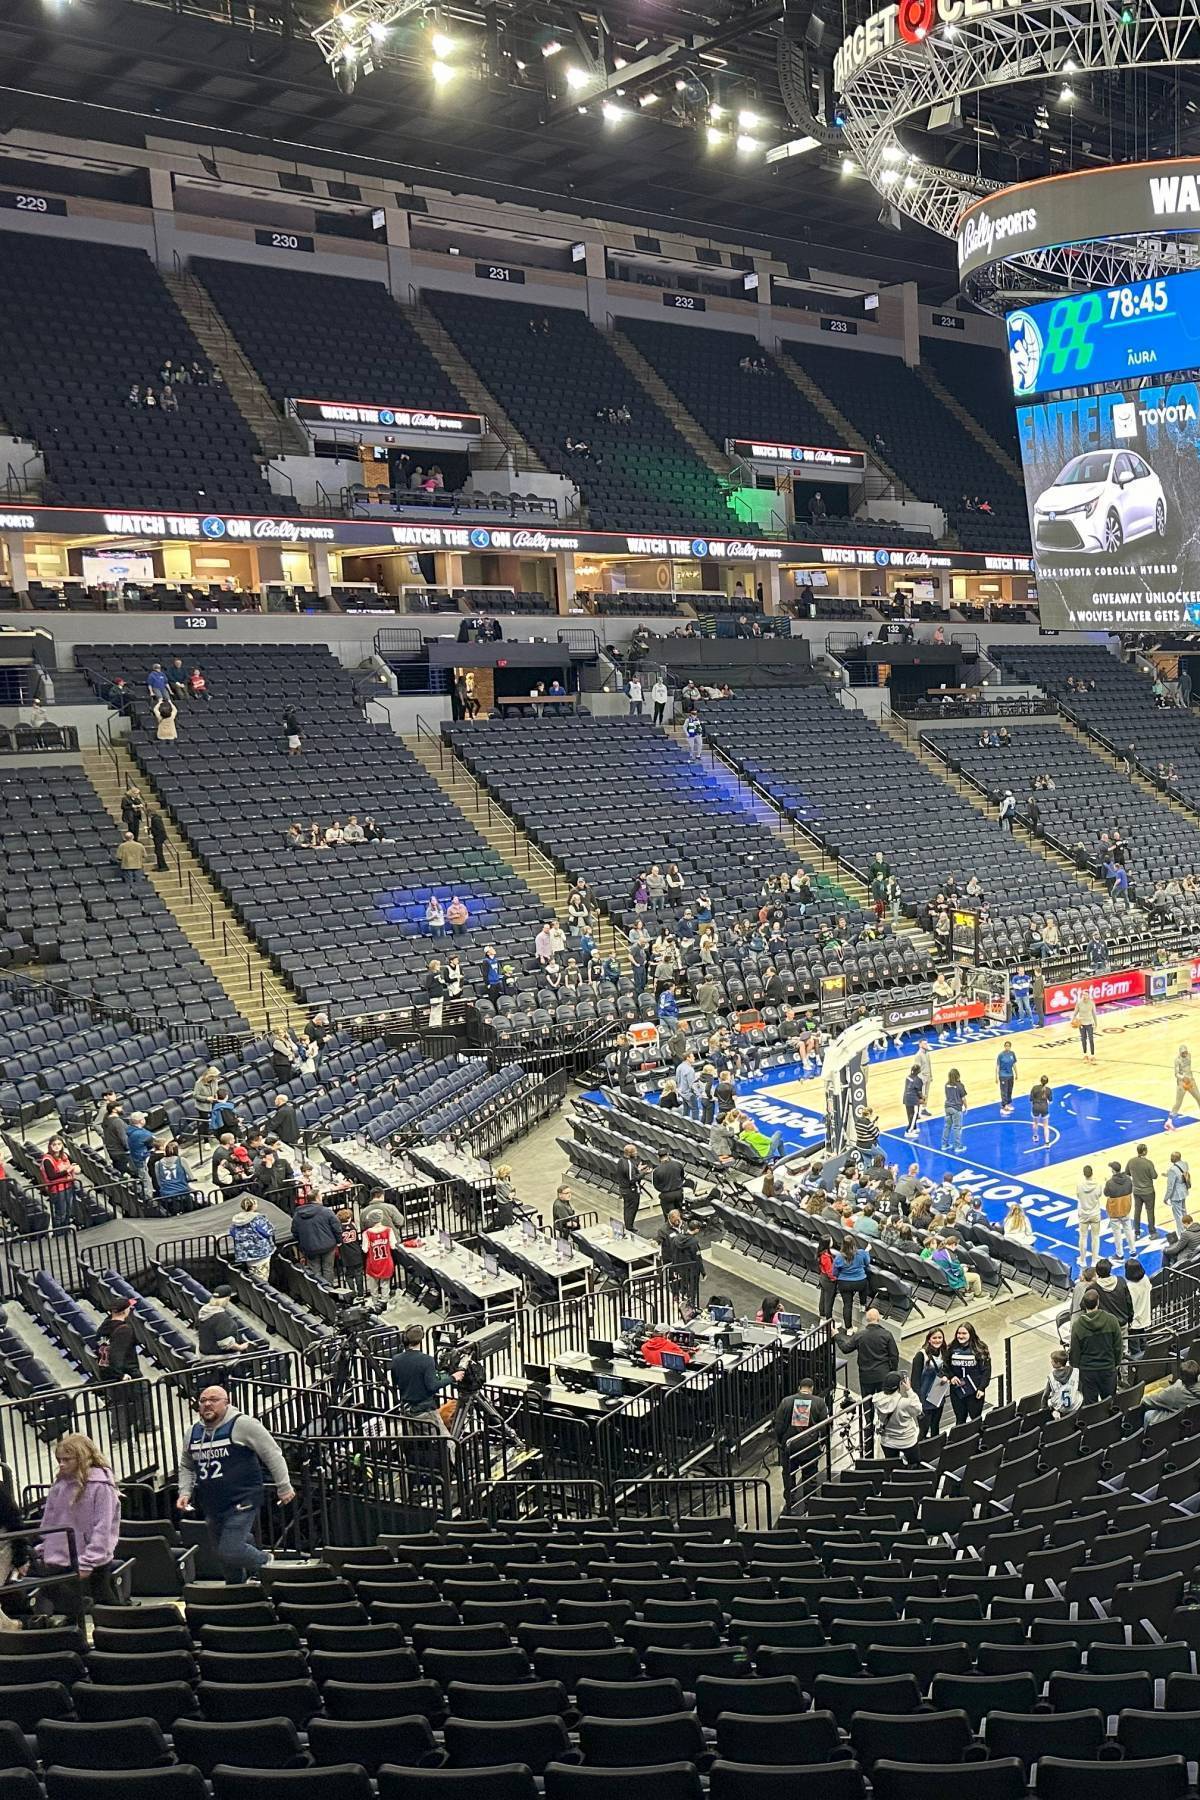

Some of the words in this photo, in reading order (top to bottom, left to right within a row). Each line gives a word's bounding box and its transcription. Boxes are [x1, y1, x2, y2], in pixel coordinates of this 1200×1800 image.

[833, 4, 899, 92] TARGET
[16, 196, 48, 212] 229
[964, 211, 995, 254] Bally
[994, 208, 1037, 240] SPORTS
[271, 233, 298, 249] 230
[489, 267, 510, 281] 231
[674, 296, 695, 309] 232
[1107, 281, 1168, 320] 78:45
[830, 320, 848, 332] 233
[941, 316, 956, 327] 234
[320, 405, 358, 422] WATCH
[411, 413, 441, 430] Bally
[1138, 402, 1197, 427] TOYOTA
[104, 514, 166, 534] WATCH
[167, 516, 199, 536] THE
[227, 518, 251, 537] ON
[253, 519, 302, 541] Bally
[300, 527, 334, 539] SPORTS
[392, 527, 443, 545] WATCH
[443, 529, 469, 546] THE
[491, 530, 511, 547] ON
[513, 531, 551, 551] Bally
[551, 538, 578, 549] SPORTS
[627, 537, 668, 554] WATCH
[669, 540, 691, 556] THE
[709, 541, 725, 556] ON
[727, 542, 759, 560] Bally
[821, 548, 855, 563] WATCH
[857, 550, 875, 564] THE
[890, 551, 904, 565] ON
[905, 552, 932, 568] Bally
[985, 557, 1013, 570] WATCH
[1013, 558, 1029, 571] THE
[1059, 566, 1091, 577] TOYOTA
[1095, 566, 1136, 576] COROLLA
[1140, 564, 1178, 575] HYBRID
[1092, 591, 1143, 605] GIVEAWAY
[185, 618, 207, 629] 129
[1069, 611, 1076, 622] A
[1077, 610, 1113, 623] WOLVES
[1115, 610, 1151, 622] PLAYER
[1154, 609, 1181, 622] GETS
[1183, 610, 1192, 622] A
[887, 625, 900, 633] 132
[900, 1008, 929, 1018] LEXUS
[1123, 1012, 1189, 1030] CENTER
[879, 1201, 891, 1213] 32
[342, 1230, 357, 1243] 23
[373, 1244, 388, 1261] 11
[1062, 1390, 1070, 1408] 5
[199, 1460, 223, 1480] 32
